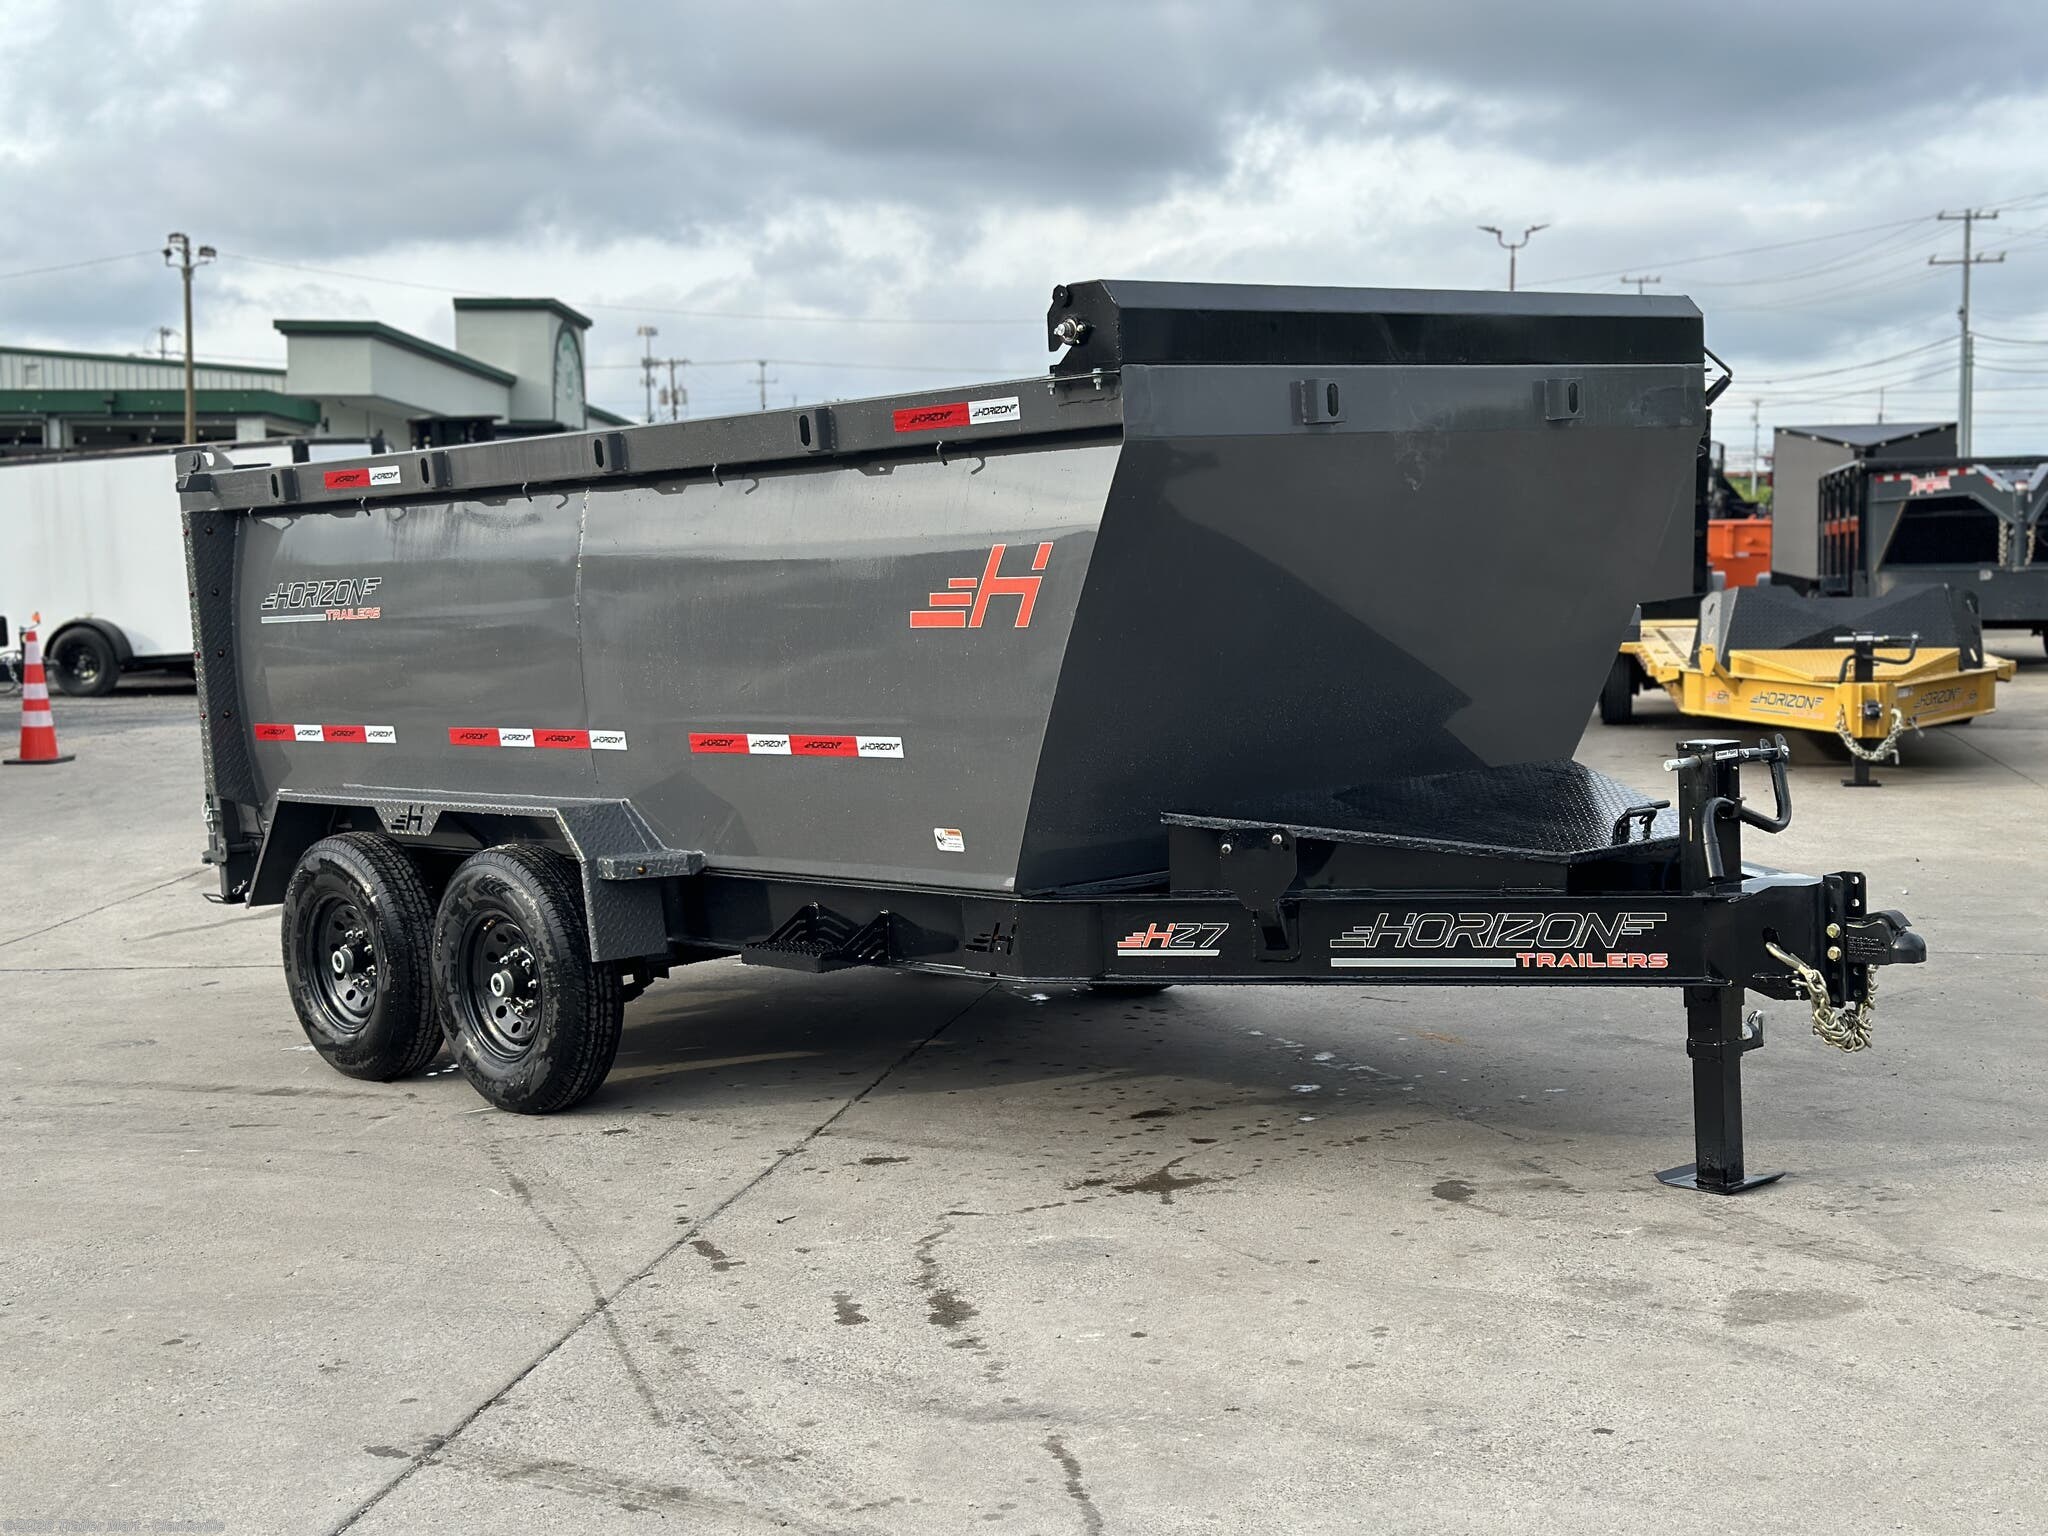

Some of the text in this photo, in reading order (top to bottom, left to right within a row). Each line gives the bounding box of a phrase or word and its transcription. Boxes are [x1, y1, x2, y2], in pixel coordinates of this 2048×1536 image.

[976, 404, 1014, 417] HORIZON
[275, 579, 367, 609] HORIZON
[326, 607, 380, 620] TRAILERS
[1759, 691, 1815, 709] HORIZON
[862, 743, 898, 751] HORIZON
[1367, 912, 1626, 948] HORIZON
[1515, 953, 1668, 968] TRAILERS
